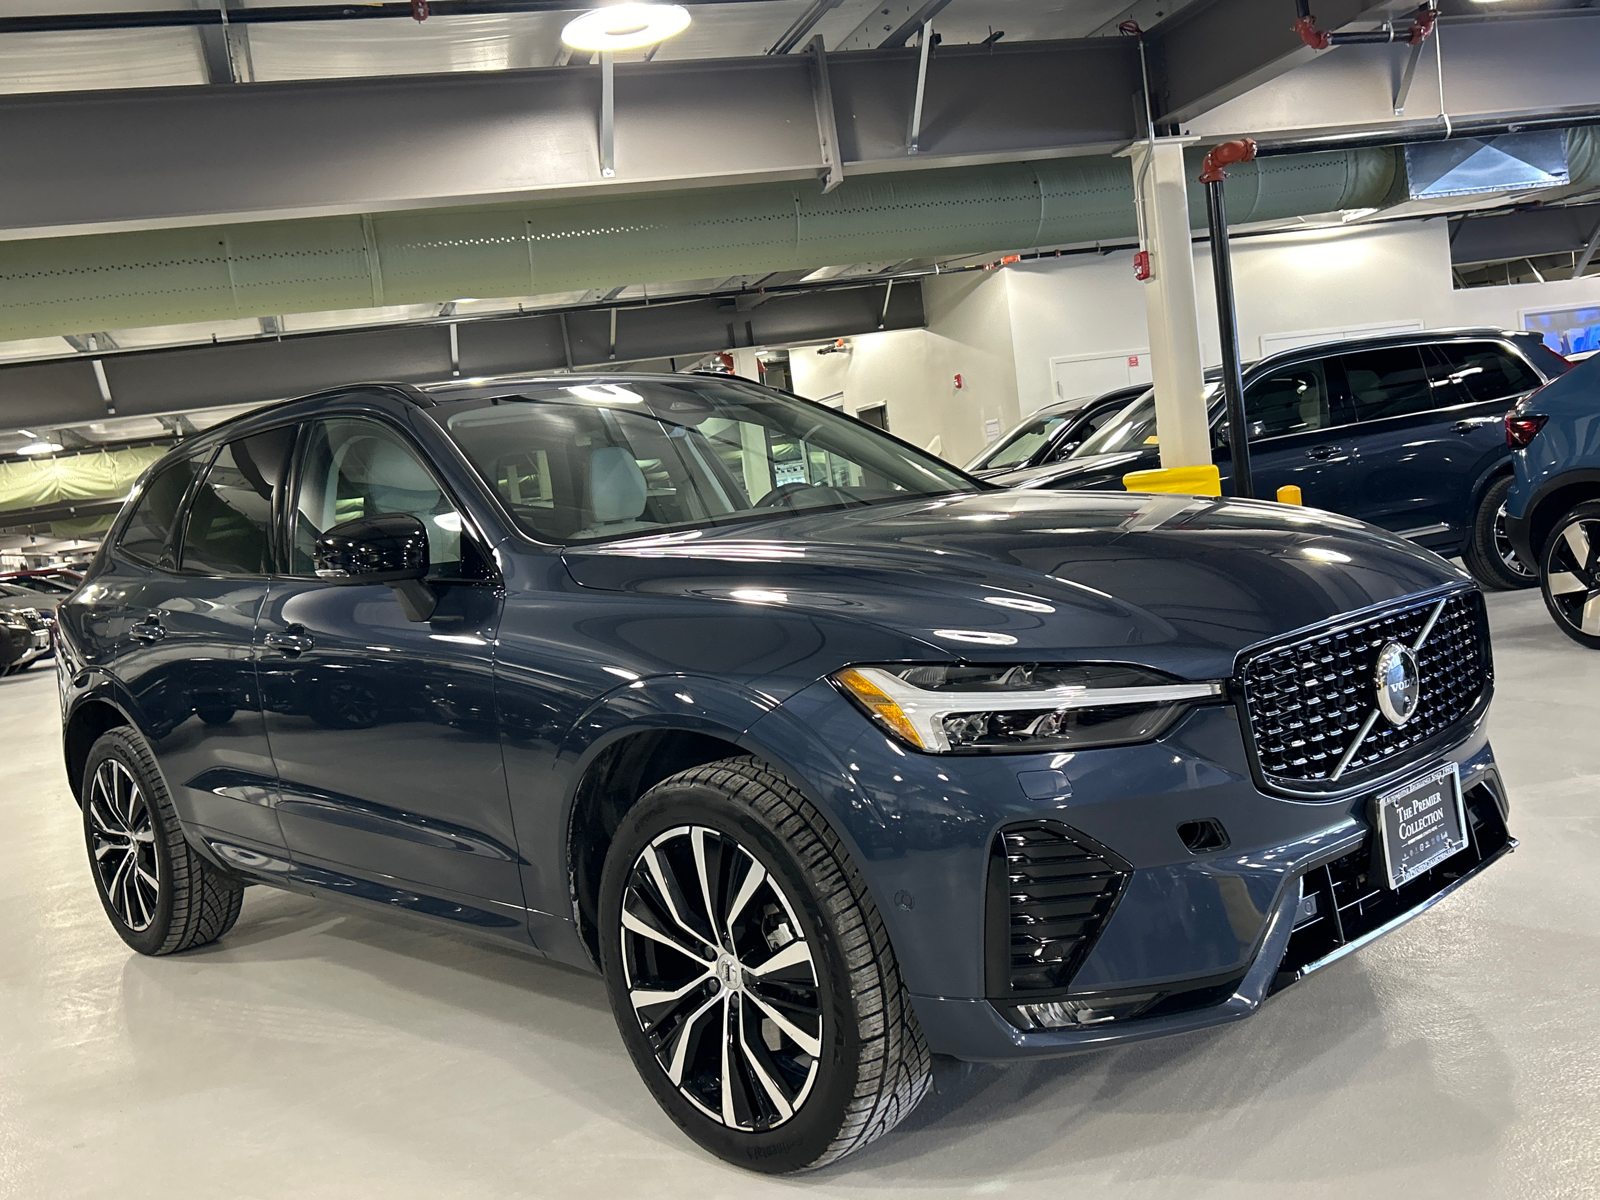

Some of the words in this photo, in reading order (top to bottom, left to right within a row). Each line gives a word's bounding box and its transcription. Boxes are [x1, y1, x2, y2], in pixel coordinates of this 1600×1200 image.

[1396, 805, 1413, 823] THE
[1412, 792, 1441, 816] PREMIER
[1398, 807, 1444, 840] COLLECTION
